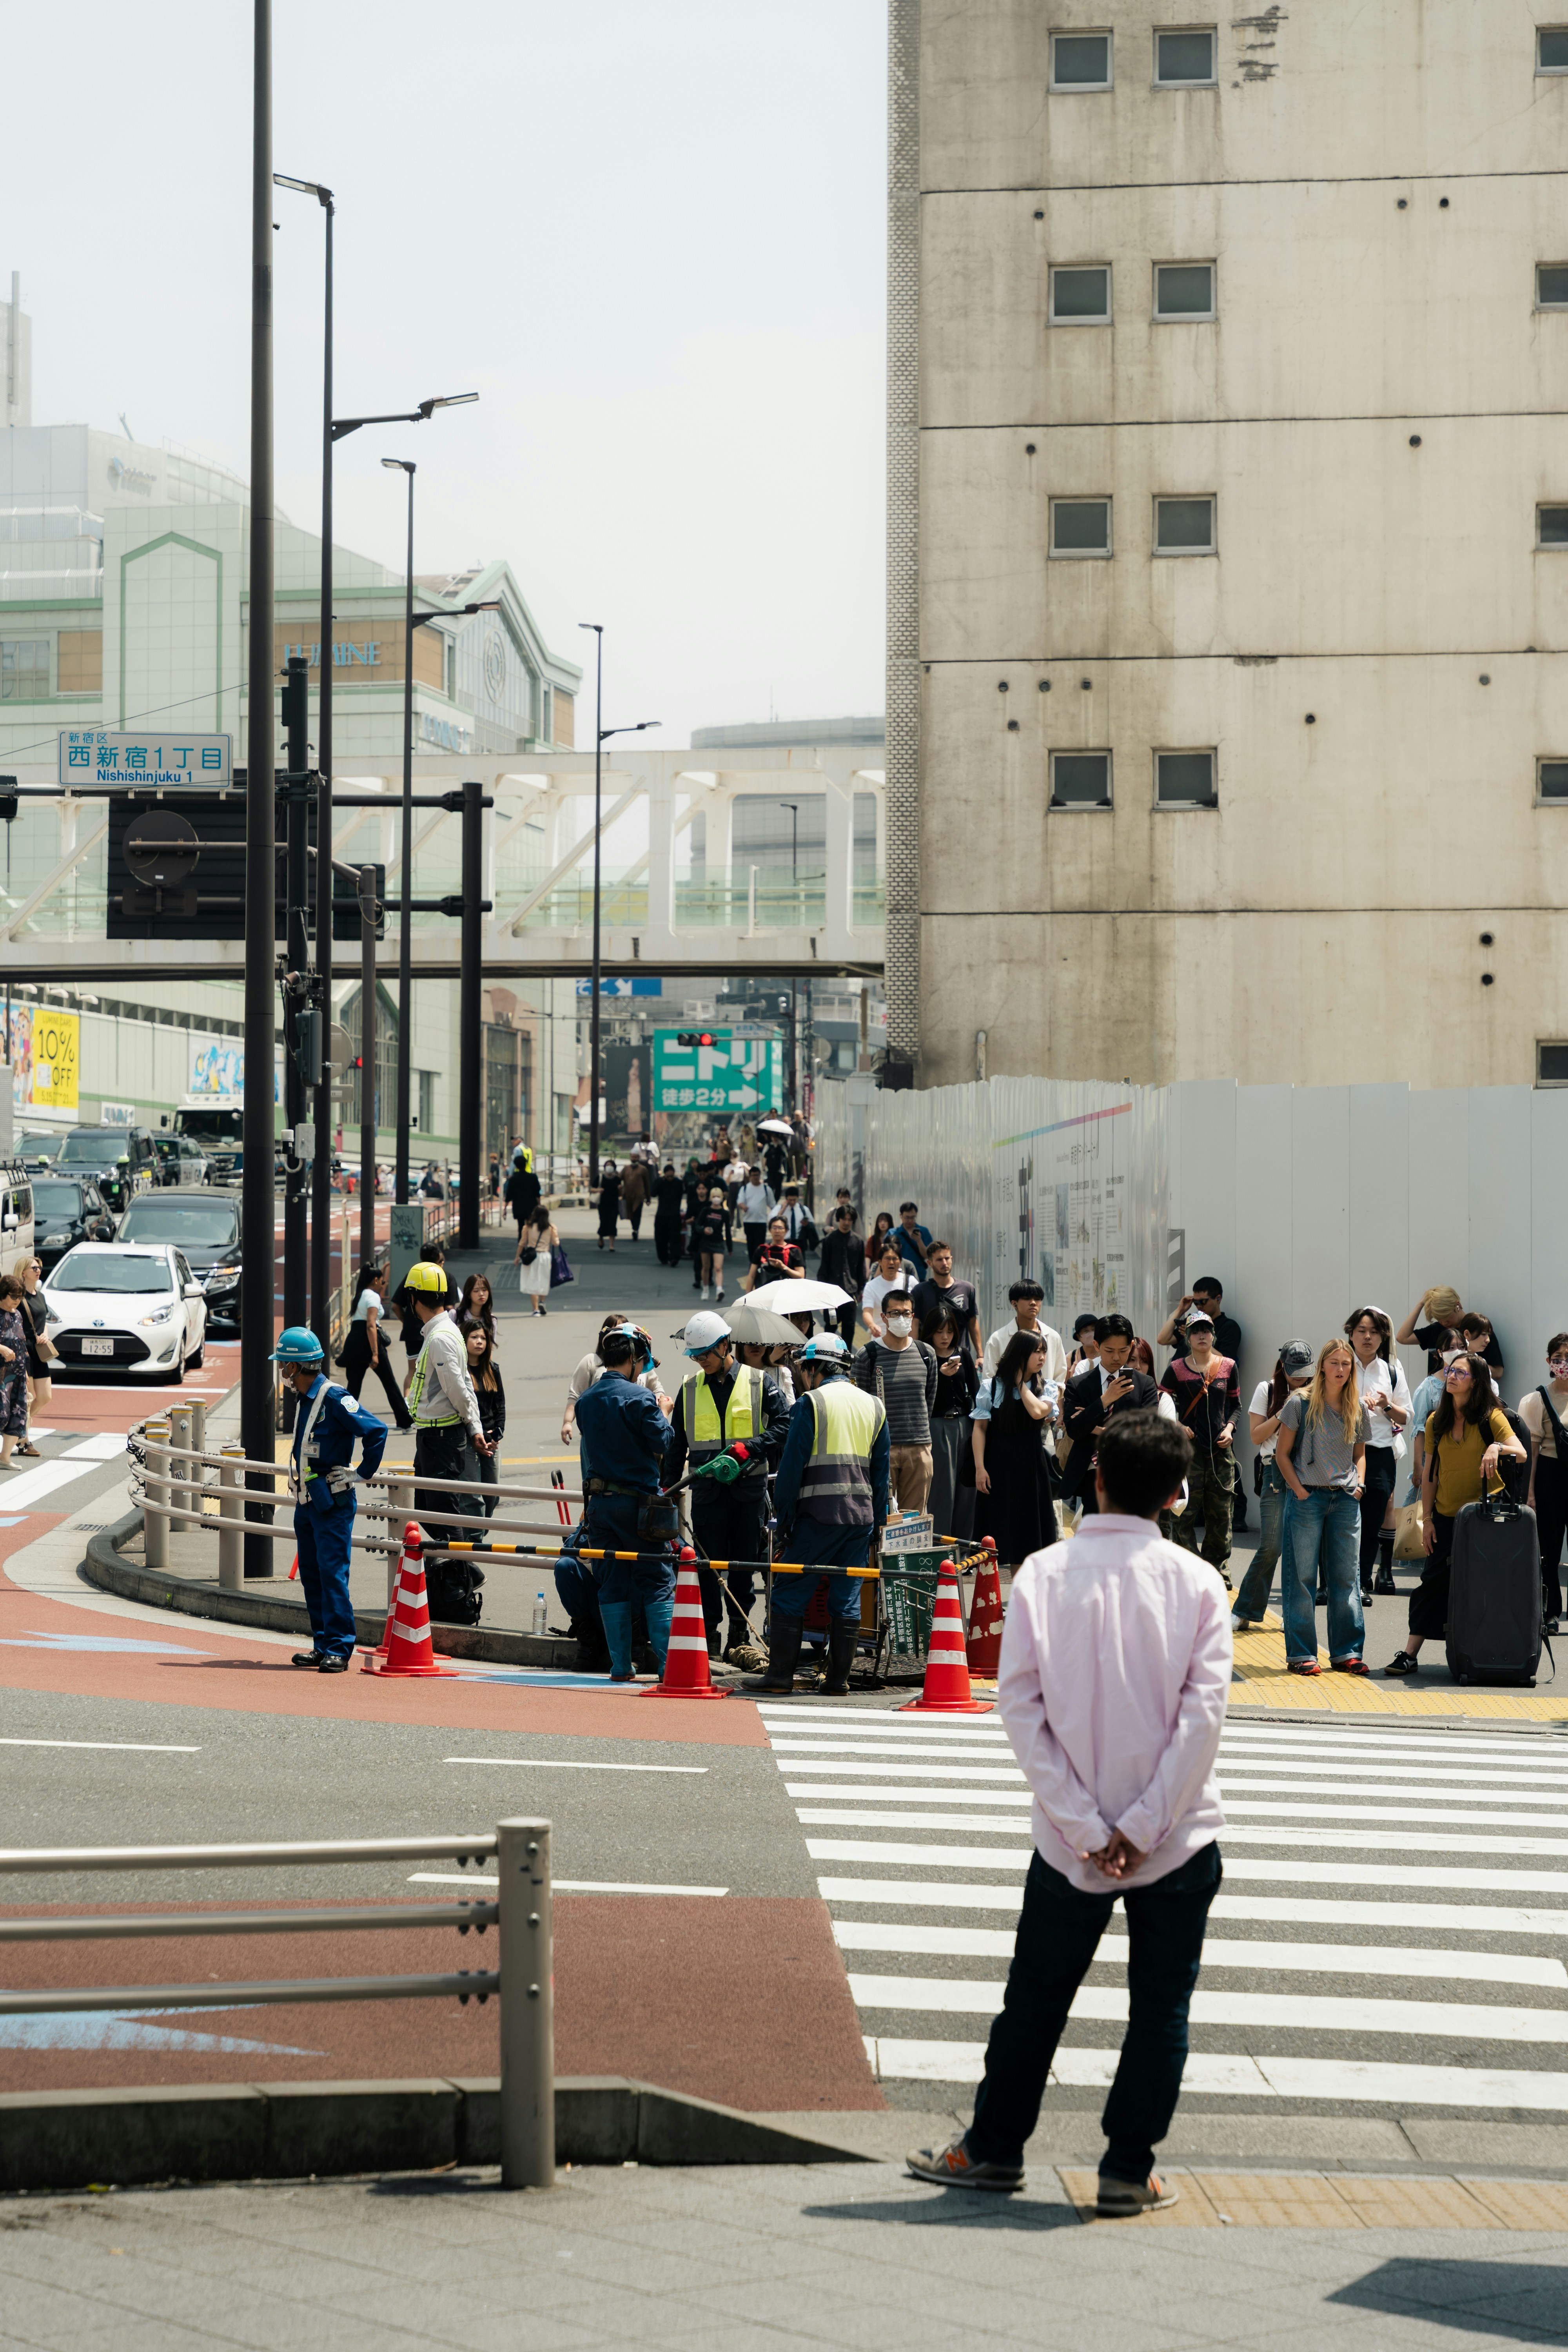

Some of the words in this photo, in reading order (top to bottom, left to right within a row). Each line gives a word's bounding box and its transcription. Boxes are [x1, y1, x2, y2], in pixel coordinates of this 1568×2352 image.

[68, 733, 108, 744] 新宿区
[68, 746, 221, 769] 西新宿1丁目
[97, 769, 181, 784] Nishishinjuku
[186, 771, 192, 782] 1
[43, 1015, 60, 1025] LUMINE
[60, 1018, 72, 1027] CARD
[39, 1028, 74, 1063] 10%
[661, 1039, 767, 1081] ニトリ
[662, 1088, 726, 1107] 徒歩2分
[887, 1523, 930, 1538] ご迷惑をおかけします
[889, 1534, 929, 1550] 下水道の調査
[894, 1580, 905, 1642] 新宿区西新宿二丁目
